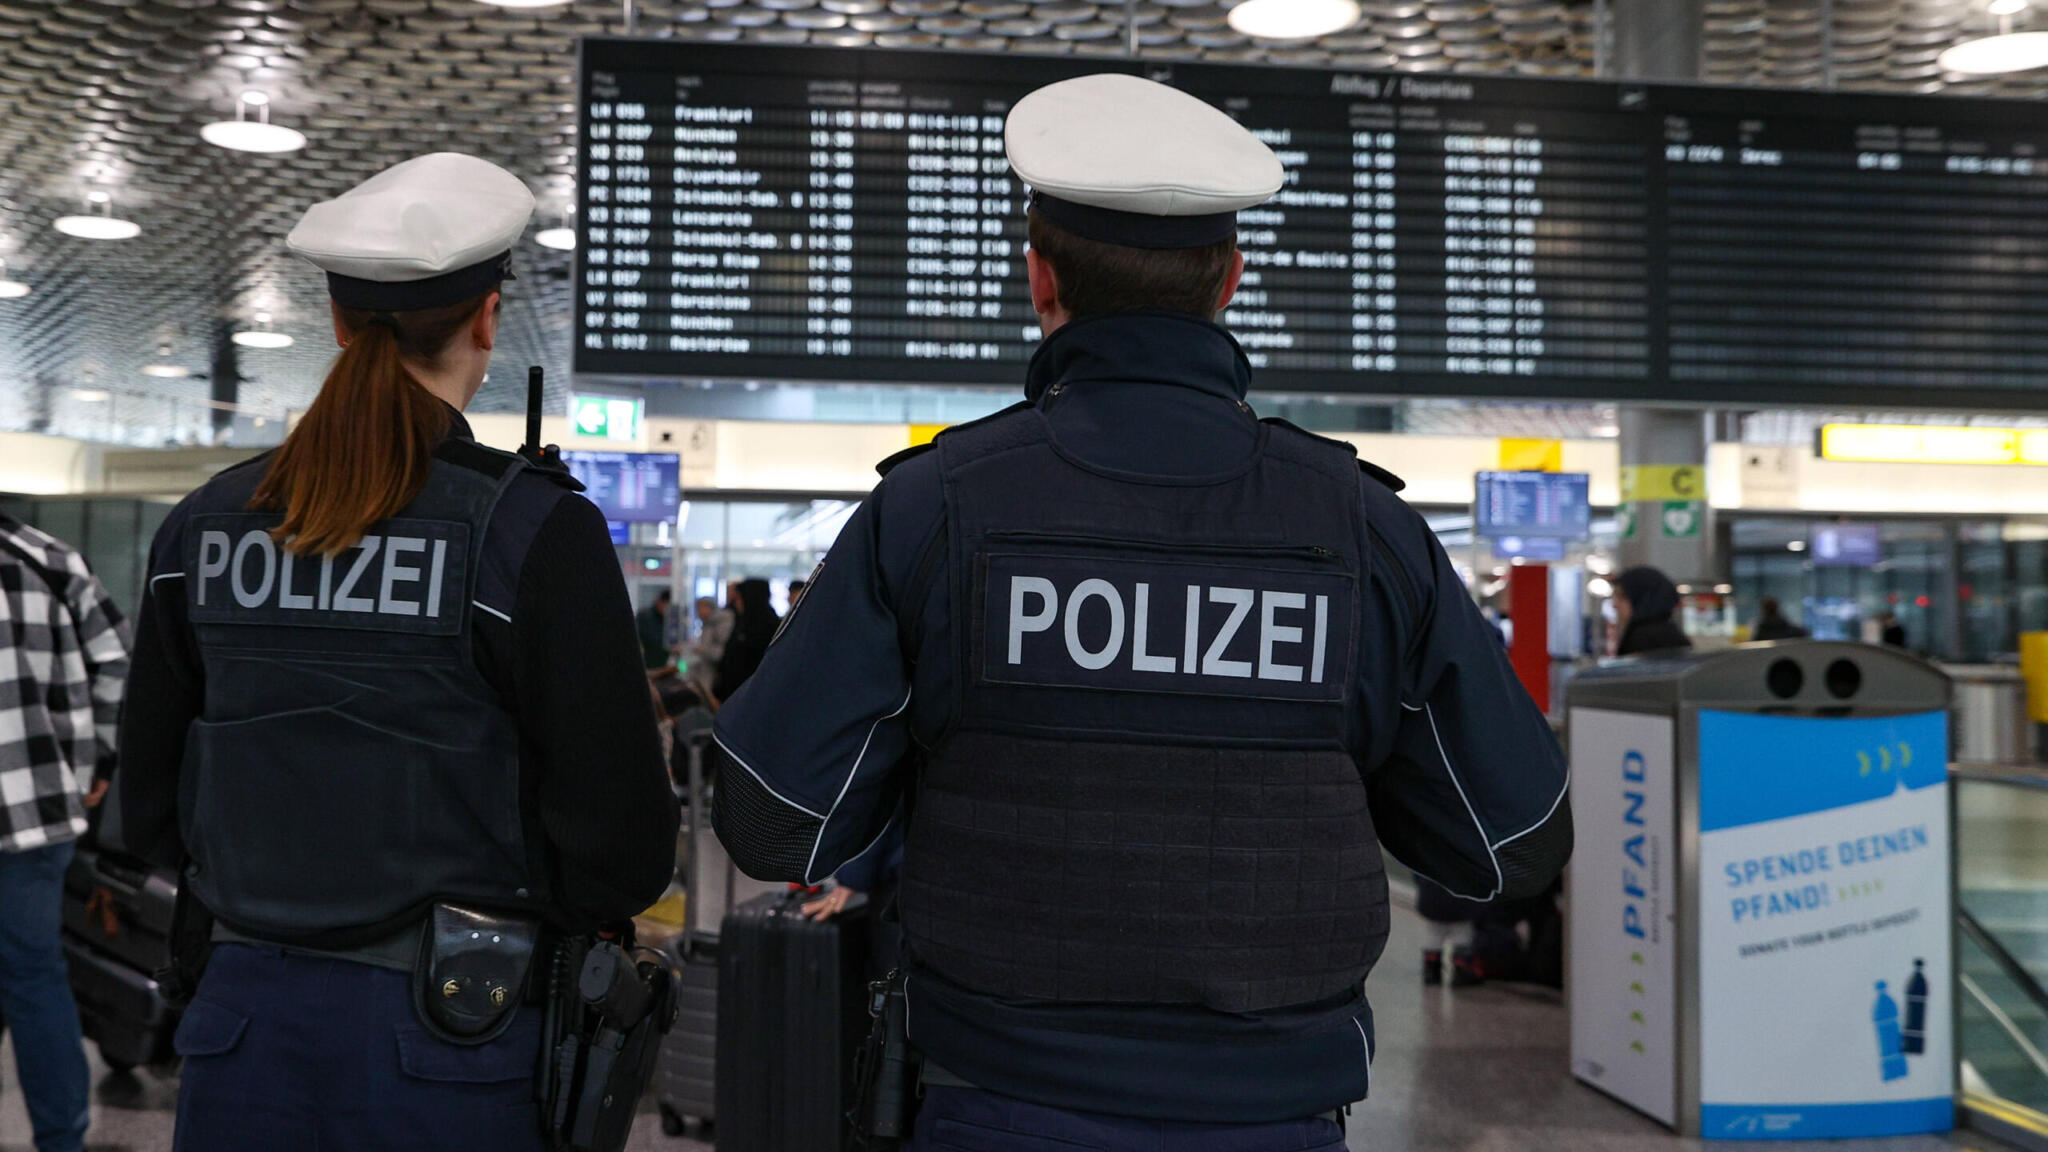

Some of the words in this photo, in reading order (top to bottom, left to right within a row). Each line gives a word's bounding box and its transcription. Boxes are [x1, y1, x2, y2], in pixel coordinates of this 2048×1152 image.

[1673, 468, 1695, 495] C
[198, 530, 446, 617] POLIZEI
[1008, 576, 1328, 683] POLIZEI
[1622, 749, 1646, 938] PFAND
[1724, 846, 1831, 888] SPENDE
[1838, 824, 1928, 867] DEINEN
[1731, 881, 1829, 923] PFAND!
